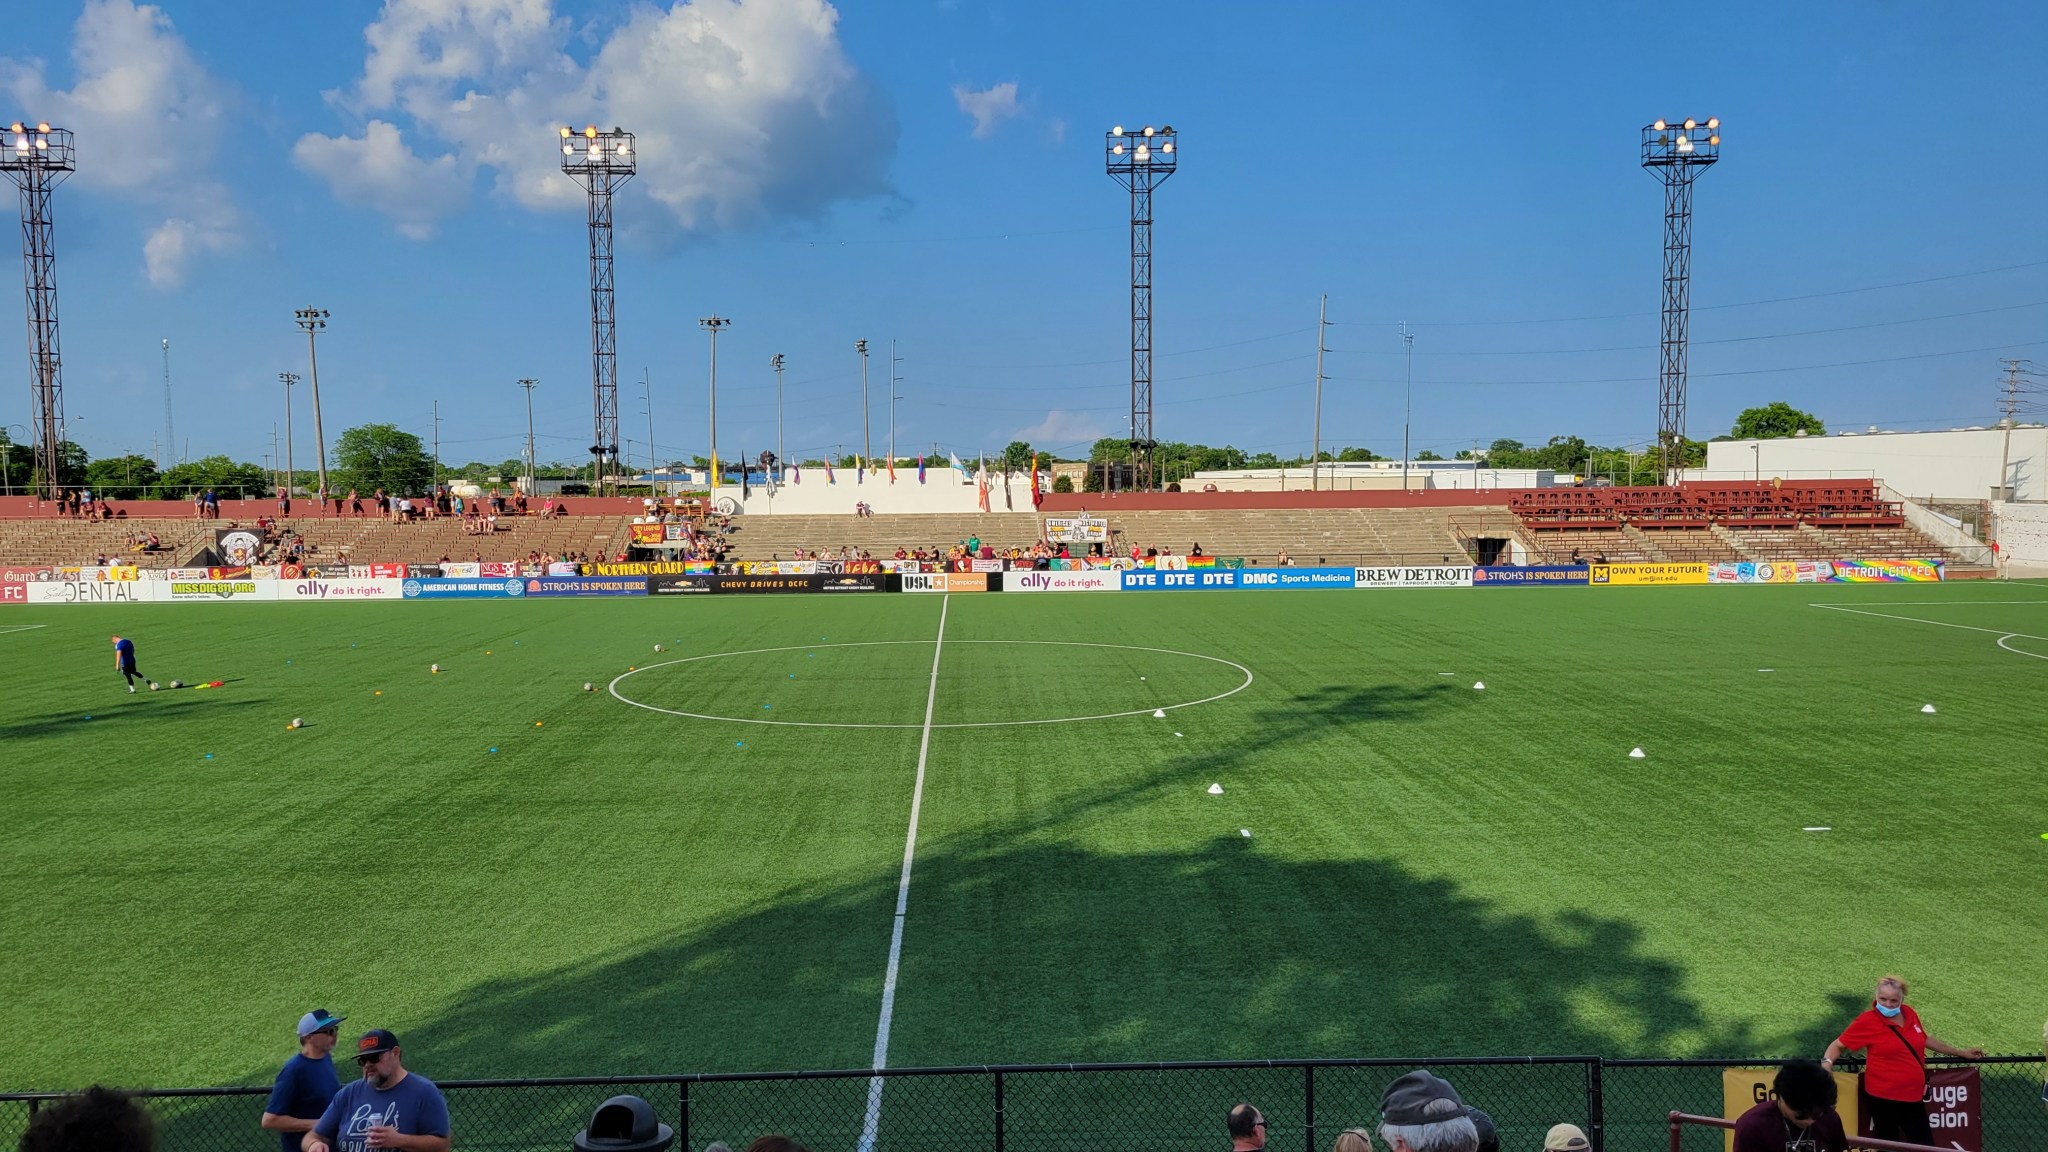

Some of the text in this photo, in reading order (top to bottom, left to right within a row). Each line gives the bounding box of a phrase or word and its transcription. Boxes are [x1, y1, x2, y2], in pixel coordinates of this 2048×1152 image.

[597, 562, 648, 576] NORTHERN
[649, 561, 684, 575] GUARD
[1356, 568, 1472, 581] BREW DETROIT
[1594, 567, 1608, 577] M
[1638, 566, 1665, 574] YOUR
[1838, 566, 1931, 578] DETROIT CITY FC
[4, 570, 36, 582] Guard
[1125, 573, 1234, 586] DTE DTE DTE
[1243, 573, 1351, 584] DMC Sports Medicine
[1488, 570, 1588, 580] STROH'S IS SPOKEN HERE
[458, 583, 477, 591] HOME
[479, 583, 505, 591] FITNESS
[543, 582, 646, 591] STROH'S IS SPOKEN HERE
[904, 576, 933, 589] USL
[949, 579, 985, 587] Championship
[1020, 573, 1105, 590] ally do it right.
[4, 586, 24, 599] FC
[64, 581, 139, 602] DENTAL
[296, 581, 385, 598] ally do it right.
